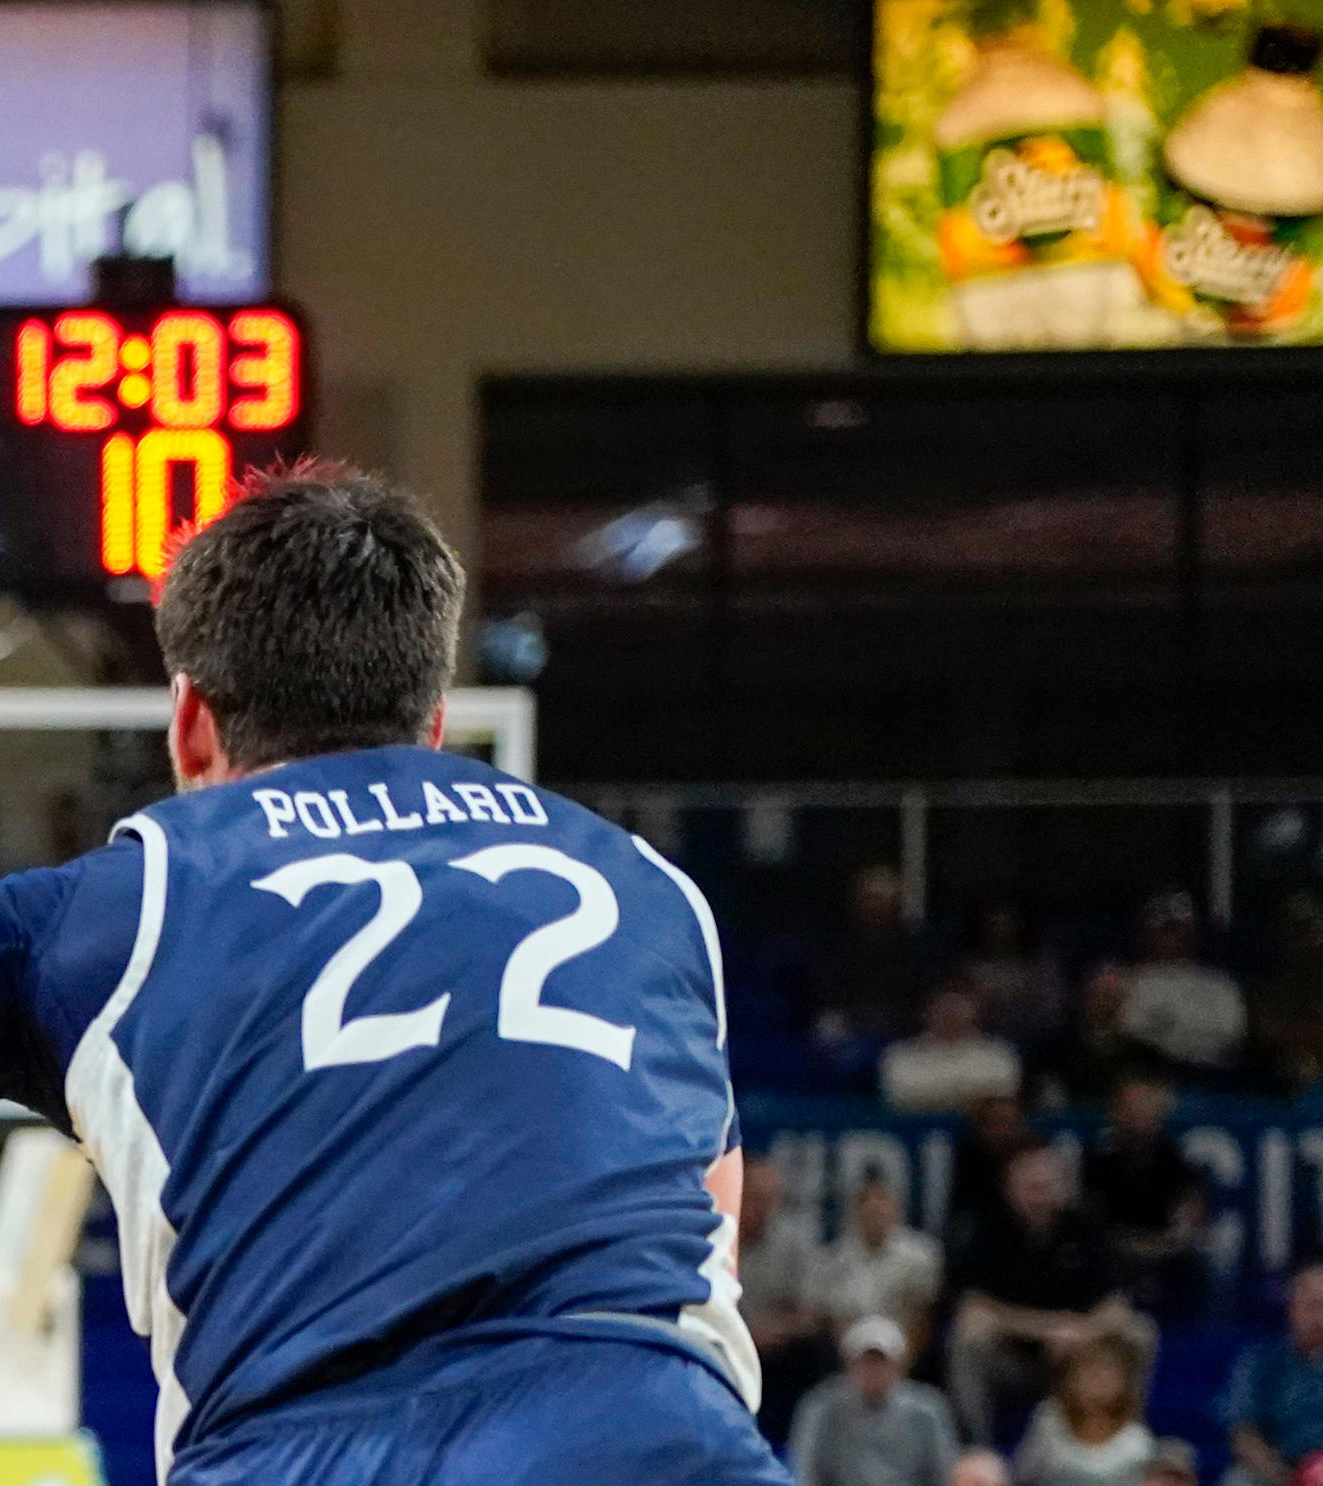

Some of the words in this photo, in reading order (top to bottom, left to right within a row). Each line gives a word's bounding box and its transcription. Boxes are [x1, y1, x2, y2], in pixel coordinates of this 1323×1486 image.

[16, 308, 301, 432] 12:03
[100, 426, 234, 578] 10
[253, 779, 550, 839] POLLARD
[250, 842, 637, 1073] 22
